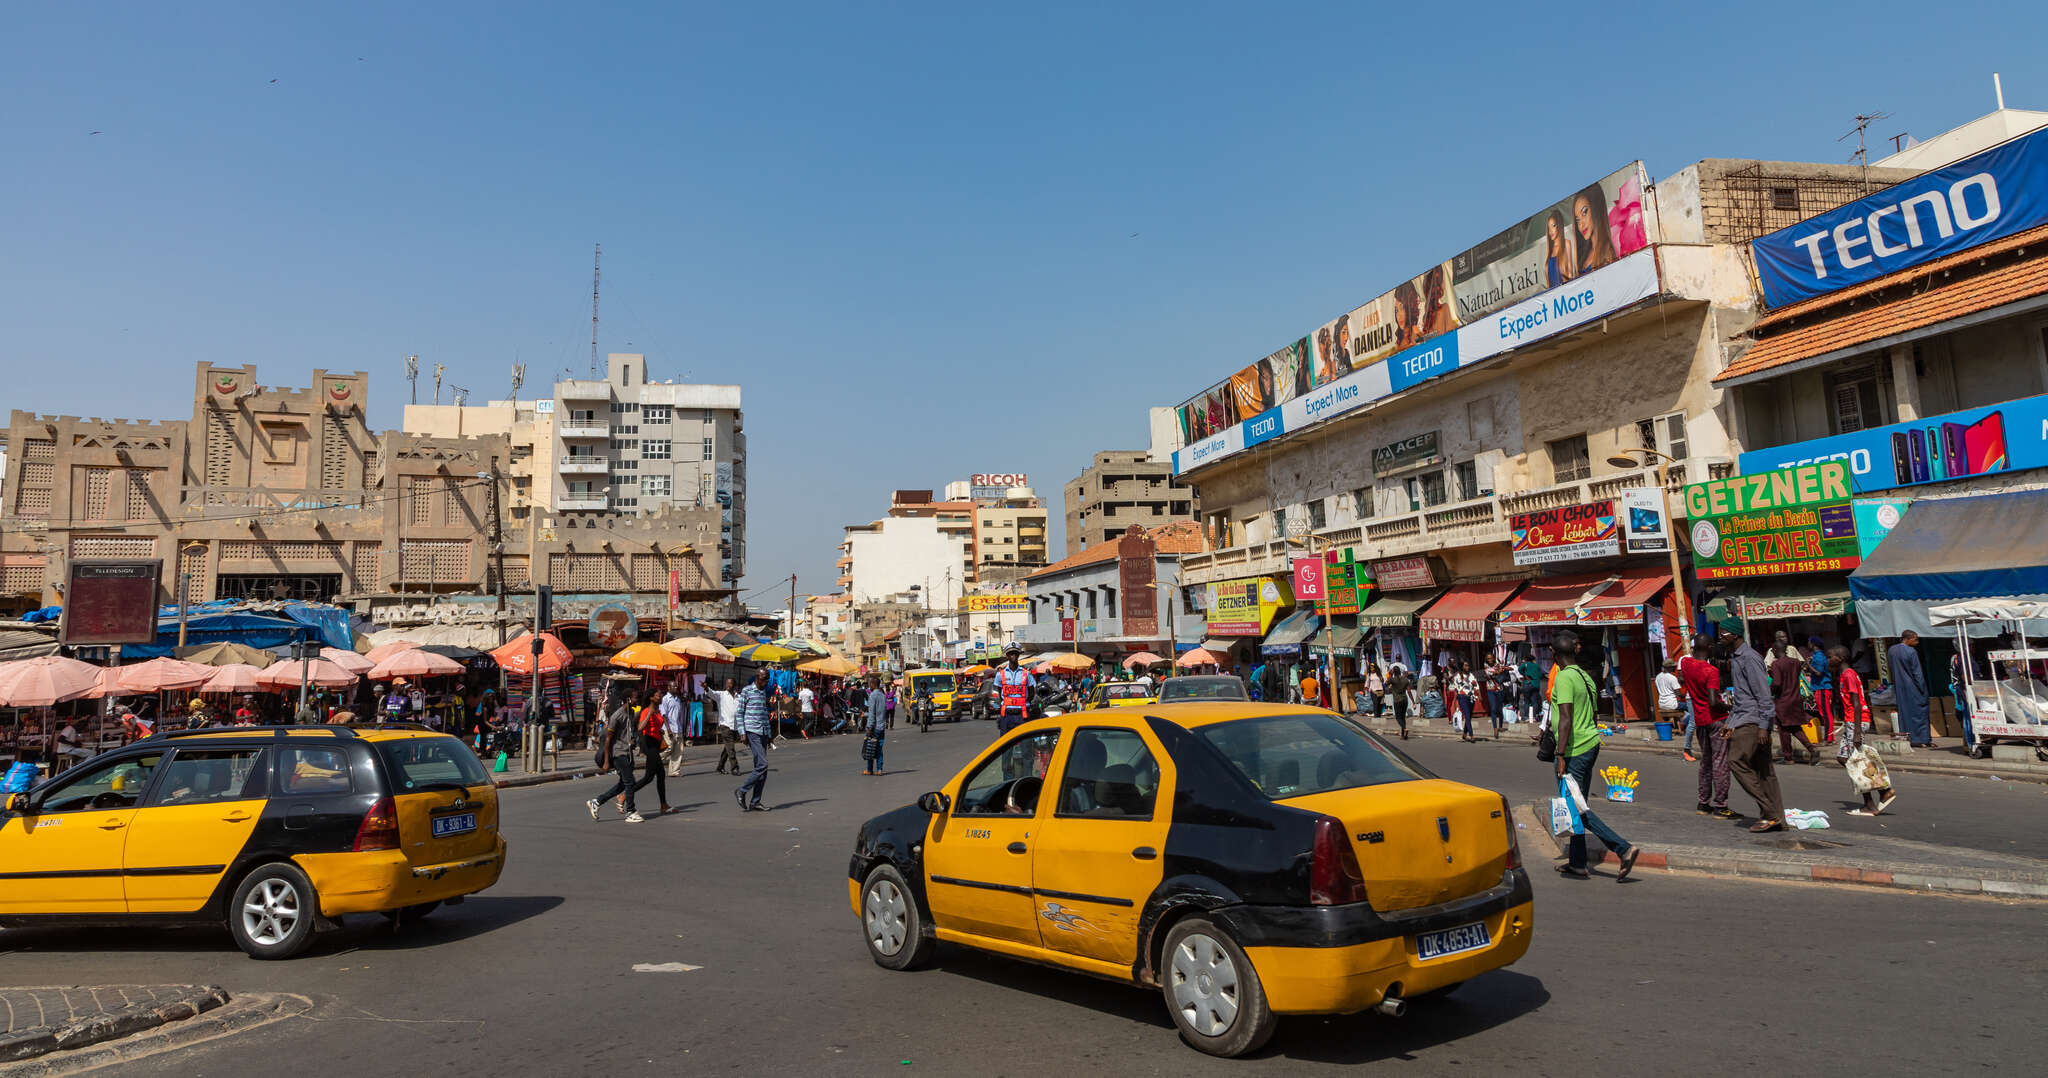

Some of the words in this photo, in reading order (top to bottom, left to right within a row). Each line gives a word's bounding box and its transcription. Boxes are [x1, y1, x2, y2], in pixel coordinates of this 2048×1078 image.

[1794, 172, 2002, 280] TECNO
[1460, 279, 1504, 317] Natural
[1508, 263, 1539, 294] Yaki
[1499, 303, 1549, 340] Expect
[1553, 289, 1595, 320] More
[1402, 347, 1443, 377] TECNO
[1304, 393, 1334, 417] Expect
[1335, 384, 1359, 404] More
[1250, 416, 1276, 438] TECNO
[1193, 443, 1211, 462] Expect
[1211, 429, 1226, 453] More
[972, 473, 1027, 486] RICOH
[1686, 462, 1849, 518] GETZNER
[1513, 516, 1526, 530] LE
[1529, 510, 1559, 528] BON
[1563, 500, 1610, 522] CHOIX
[1718, 518, 1732, 536] Le
[1732, 513, 1767, 534] Prince
[1768, 511, 1784, 530] du
[1784, 508, 1817, 527] Bazin
[1527, 526, 1556, 547] Chez
[1561, 522, 1597, 543] Lebbar
[1721, 529, 1824, 565] GETZNER
[1376, 563, 1391, 574] LE
[1391, 557, 1425, 572] BAZIN
[1730, 567, 1740, 577] 77
[1741, 566, 1757, 576] 378
[1758, 565, 1768, 575] 95
[1769, 564, 1780, 574] 18
[1785, 562, 1796, 572] 77
[1798, 561, 1815, 571] 515
[1816, 560, 1828, 570] 25
[1829, 559, 1841, 569] 93
[1303, 584, 1317, 594] LG
[1218, 596, 1247, 609] GETZNER
[1752, 601, 1819, 616] Getzner
[1370, 616, 1381, 626] LE
[1382, 615, 1409, 626] BAZIN
[1420, 618, 1440, 630] ETS
[1357, 831, 1385, 841] LOGAN
[1423, 923, 1488, 957] DK-4853-AT
